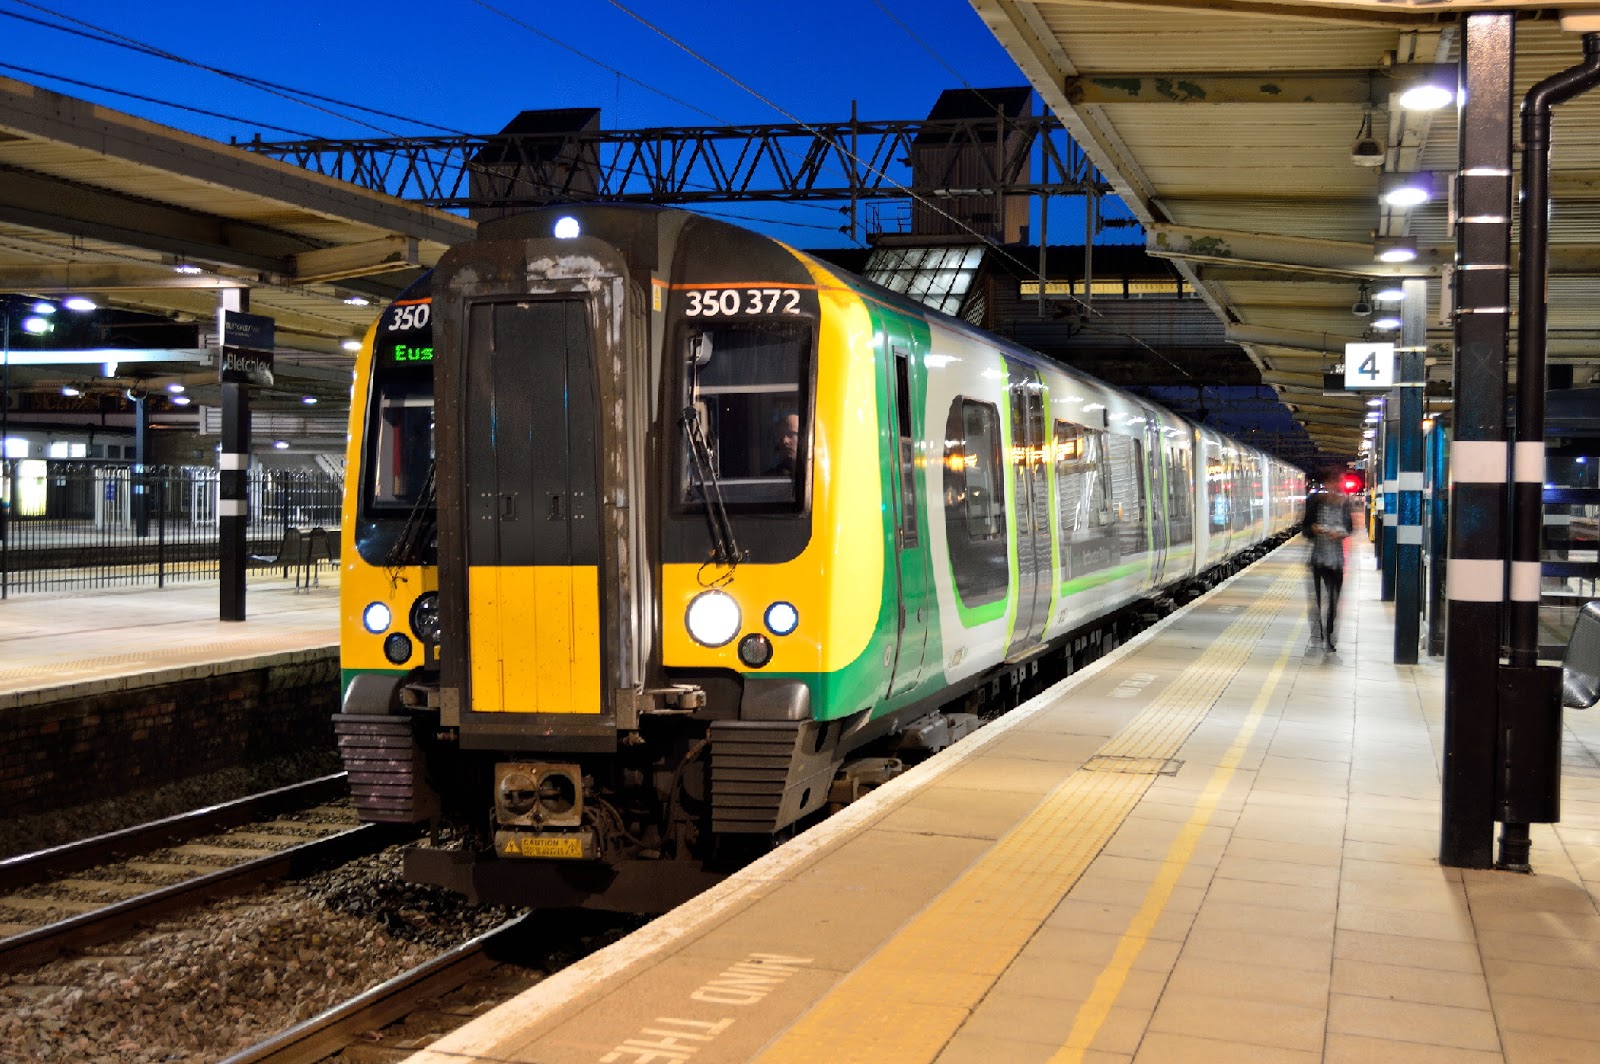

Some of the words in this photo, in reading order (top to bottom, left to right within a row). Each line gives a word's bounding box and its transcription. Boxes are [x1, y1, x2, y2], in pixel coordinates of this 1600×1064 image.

[685, 289, 740, 316] 350
[744, 289, 801, 314] 372
[388, 304, 430, 331] 350
[1358, 352, 1380, 380] 4
[690, 952, 815, 1006] MIND
